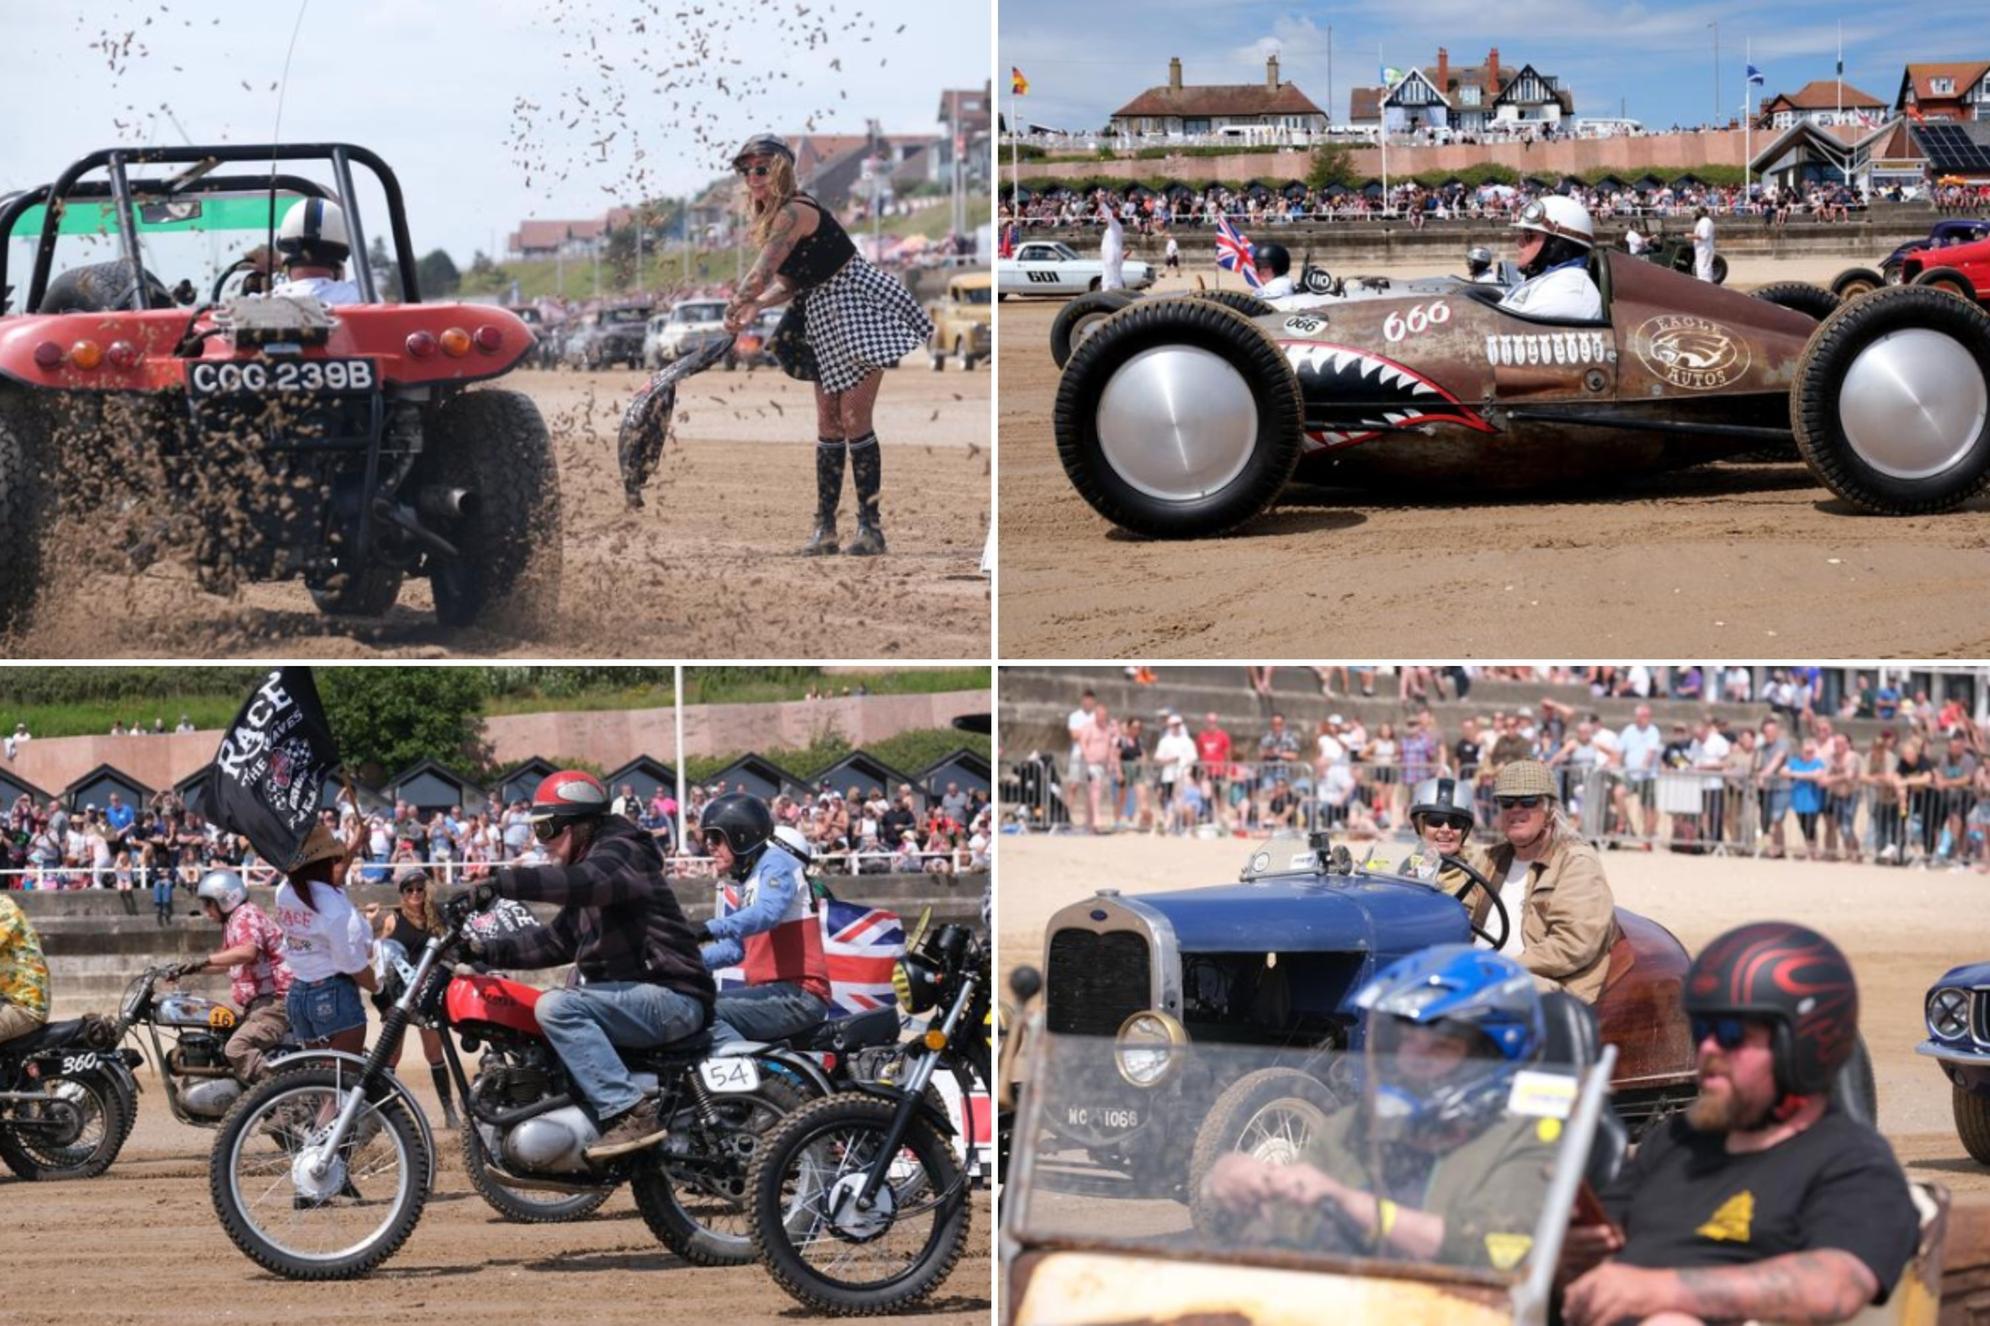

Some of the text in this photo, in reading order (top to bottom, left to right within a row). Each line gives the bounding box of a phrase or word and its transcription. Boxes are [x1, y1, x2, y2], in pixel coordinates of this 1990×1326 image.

[1027, 271, 1060, 283] 601
[1286, 318, 1320, 332] 066
[1383, 300, 1451, 342] 666
[275, 360, 372, 391] 239B
[1666, 367, 1726, 387] AUTOS
[217, 670, 293, 780] RACE
[240, 757, 268, 787] THE
[212, 1011, 232, 1027] 16
[61, 1052, 97, 1075] 360
[710, 1062, 749, 1087] 54
[1104, 1109, 1138, 1128] 1066
